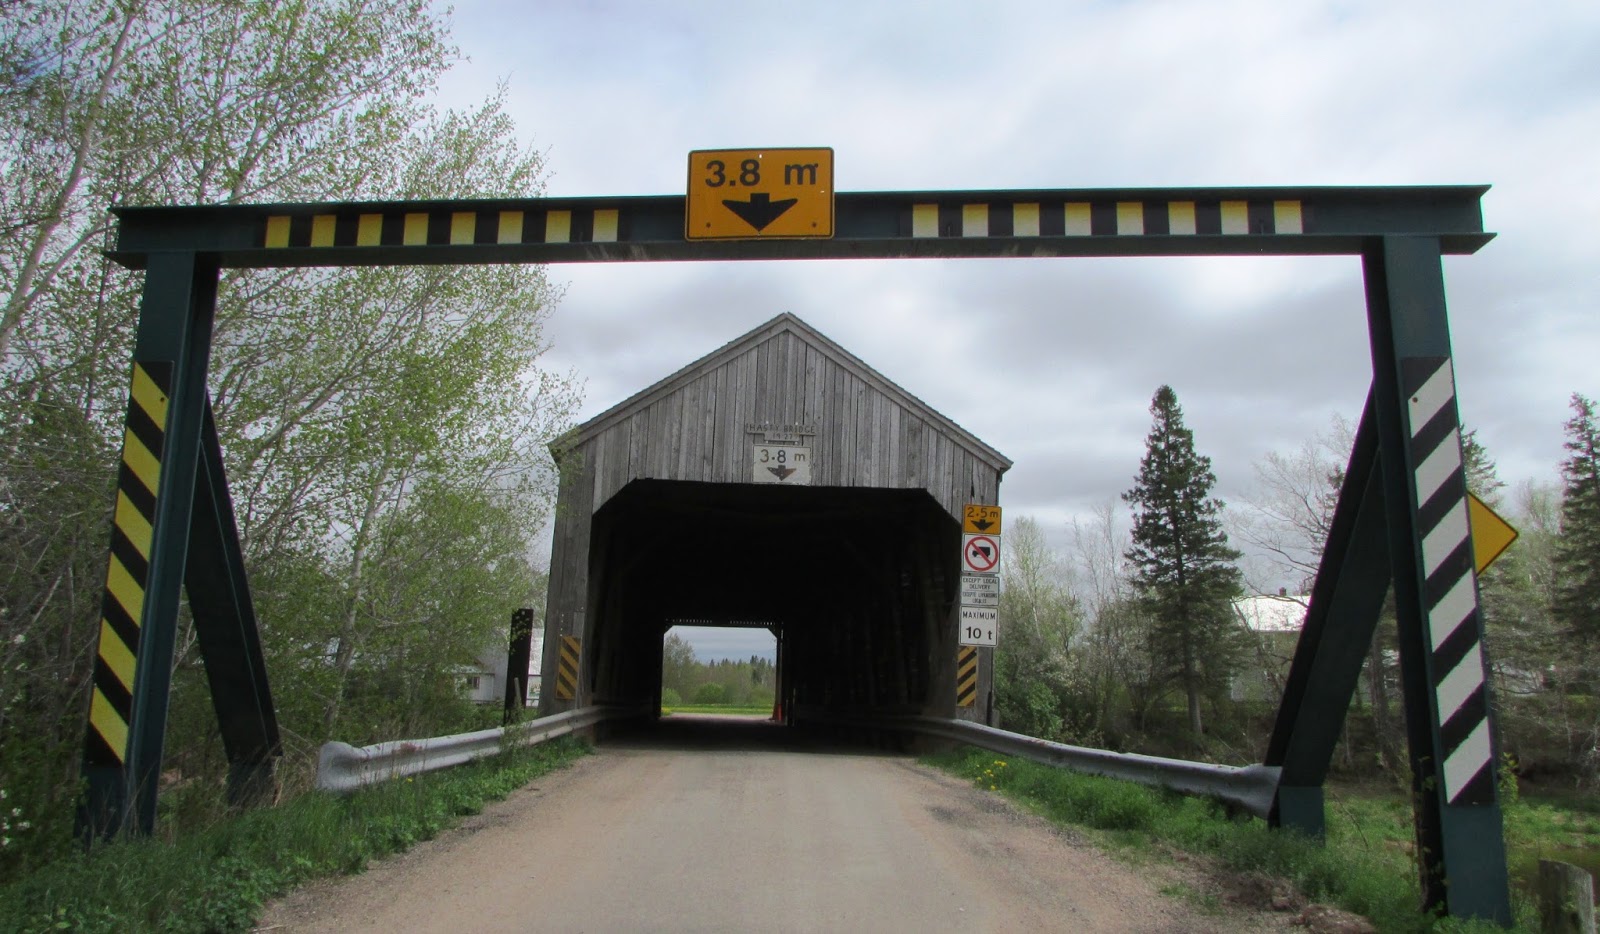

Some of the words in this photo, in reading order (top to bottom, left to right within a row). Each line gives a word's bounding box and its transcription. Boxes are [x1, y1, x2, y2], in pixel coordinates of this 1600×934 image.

[705, 159, 760, 187] 3.8
[784, 163, 818, 185] m
[783, 425, 816, 433] BRIDGE
[794, 453, 806, 461] m
[967, 507, 987, 518] 2.5
[962, 611, 996, 620] MAXIMUM
[966, 626, 982, 639] 10
[987, 630, 993, 640] t
